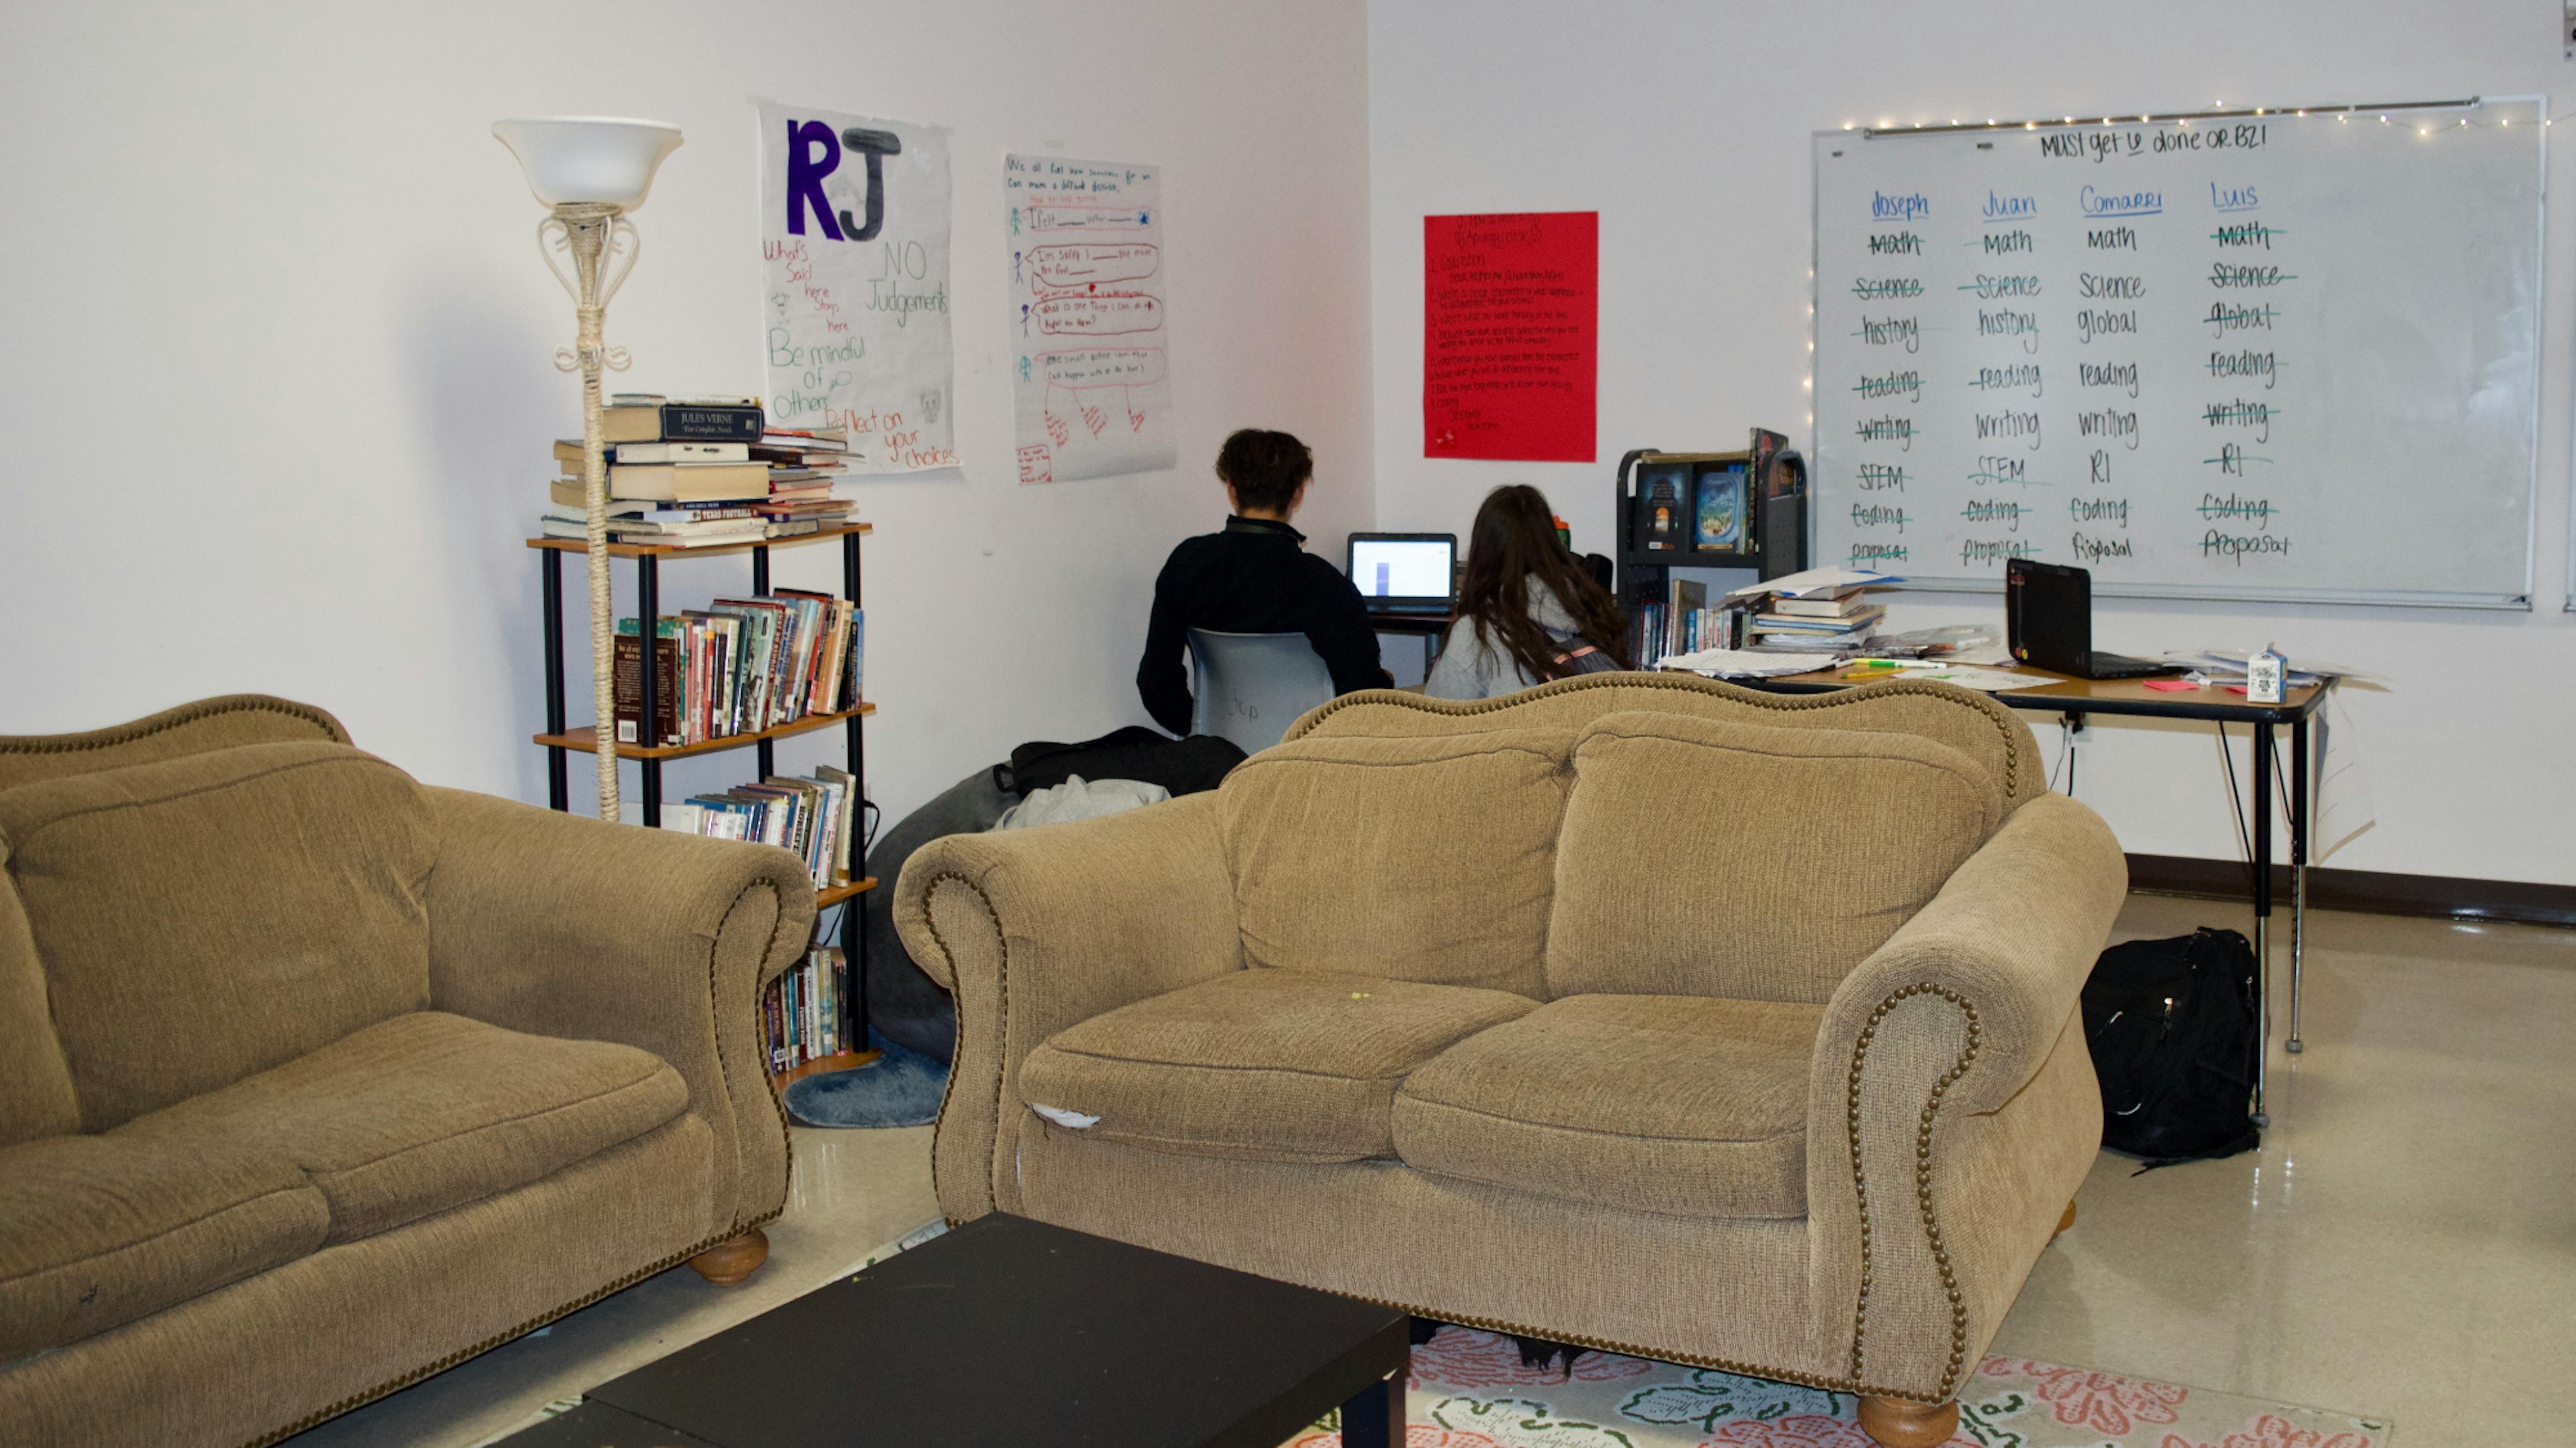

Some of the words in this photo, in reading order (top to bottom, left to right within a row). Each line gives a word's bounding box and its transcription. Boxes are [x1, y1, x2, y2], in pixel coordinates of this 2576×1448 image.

[2089, 131, 2123, 163] get
[2153, 129, 2201, 153] done
[1871, 190, 1930, 221] Joseph
[1983, 189, 2037, 217] Juan
[763, 239, 809, 262] What's
[1869, 230, 1921, 256] Math
[1983, 230, 2033, 255] Math
[2087, 226, 2137, 251] Math
[2218, 221, 2271, 250] Math
[804, 281, 829, 298] here
[866, 279, 948, 328] Judgements
[826, 317, 849, 333] here
[1862, 314, 1919, 354] history
[1978, 307, 2039, 354] history
[2077, 309, 2137, 344] global
[2210, 301, 2272, 339] global
[769, 327, 804, 367] Be
[810, 336, 866, 366] mindful
[1979, 364, 2042, 398] reading
[2079, 361, 2139, 399] reading
[2210, 349, 2276, 389] reading
[1859, 370, 1921, 403] reading
[680, 412, 705, 425] JULES
[706, 413, 734, 425] VERNE
[825, 409, 878, 435] Reflect
[883, 412, 903, 432] on
[884, 429, 920, 463] your
[1859, 463, 1905, 493] STEM
[1976, 455, 2026, 489] STEM
[702, 509, 722, 521] TEXAS
[722, 508, 752, 519] FOOTBALL
